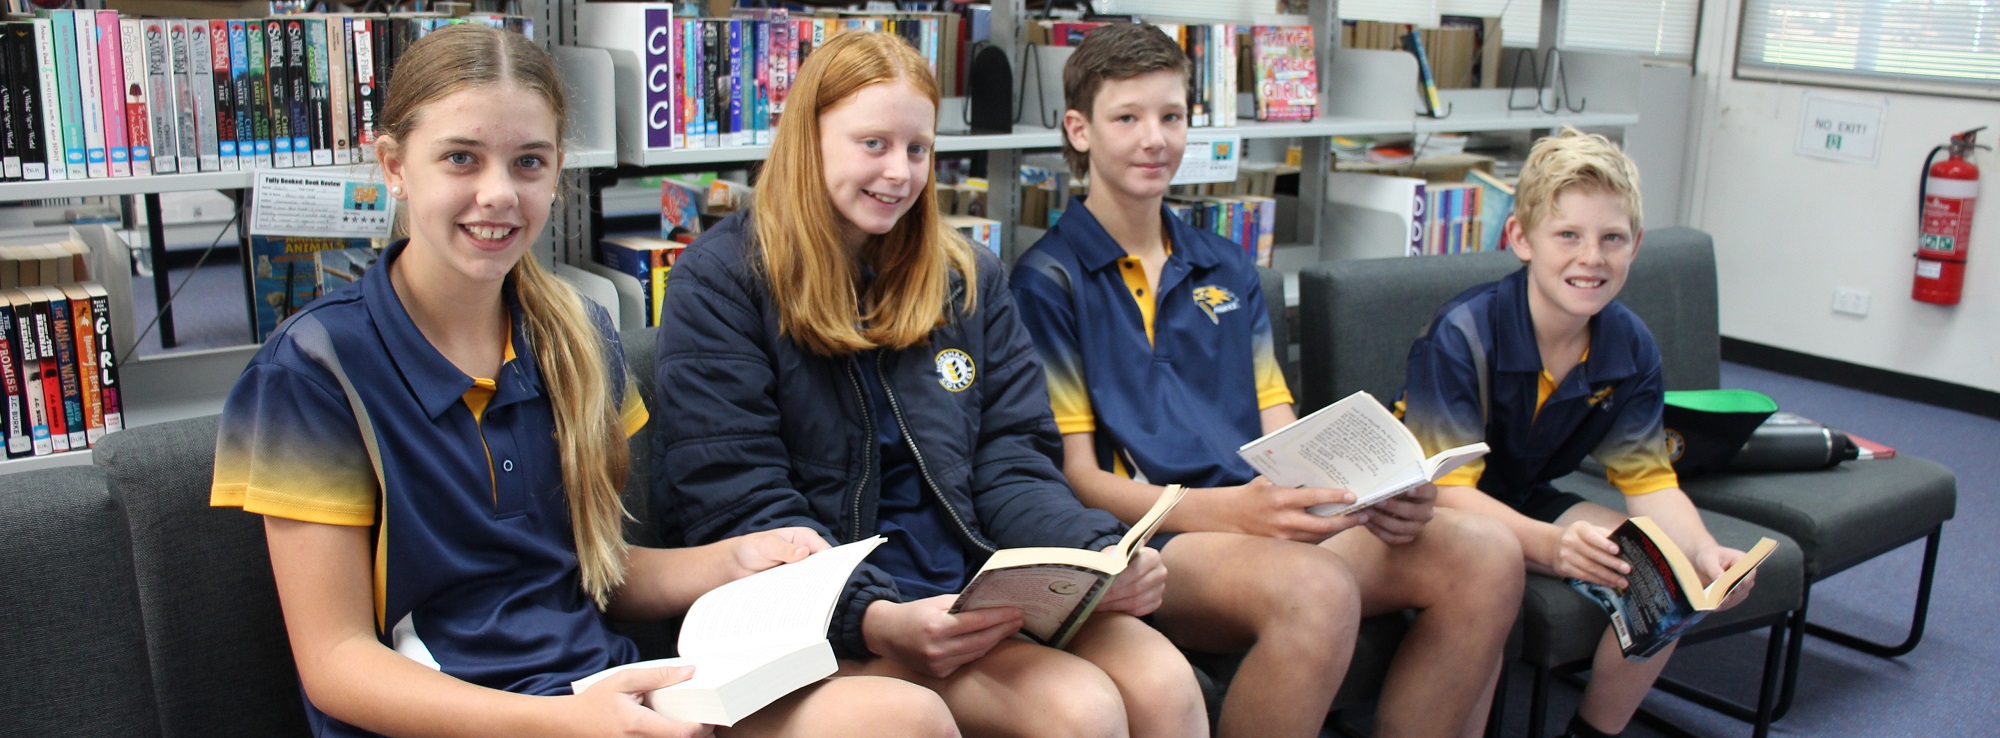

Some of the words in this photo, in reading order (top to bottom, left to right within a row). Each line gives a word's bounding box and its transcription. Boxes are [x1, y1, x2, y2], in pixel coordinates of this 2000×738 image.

[122, 25, 136, 81] Brashares
[147, 27, 164, 76] SAMURAI
[212, 29, 228, 70] SAMURAI
[231, 29, 246, 69] SAMURAI
[248, 29, 262, 69] SAMURAI
[268, 27, 283, 67] SAMURAI
[288, 27, 303, 67] SAMURAI
[1263, 32, 1307, 47] TAKE
[1262, 56, 1316, 70] THREE
[332, 64, 343, 115] ghostheart
[1263, 82, 1316, 98] GIRLS
[1815, 119, 1832, 130] NO
[1838, 121, 1867, 134] EXIT!
[19, 317, 31, 360] BRENNAN
[36, 314, 48, 357] BRENNAN
[54, 319, 70, 342] MAN
[0, 342, 18, 392] PROMISE
[96, 317, 114, 386] GIRL
[61, 363, 76, 398] WATER
[12, 411, 20, 434] BURKE
